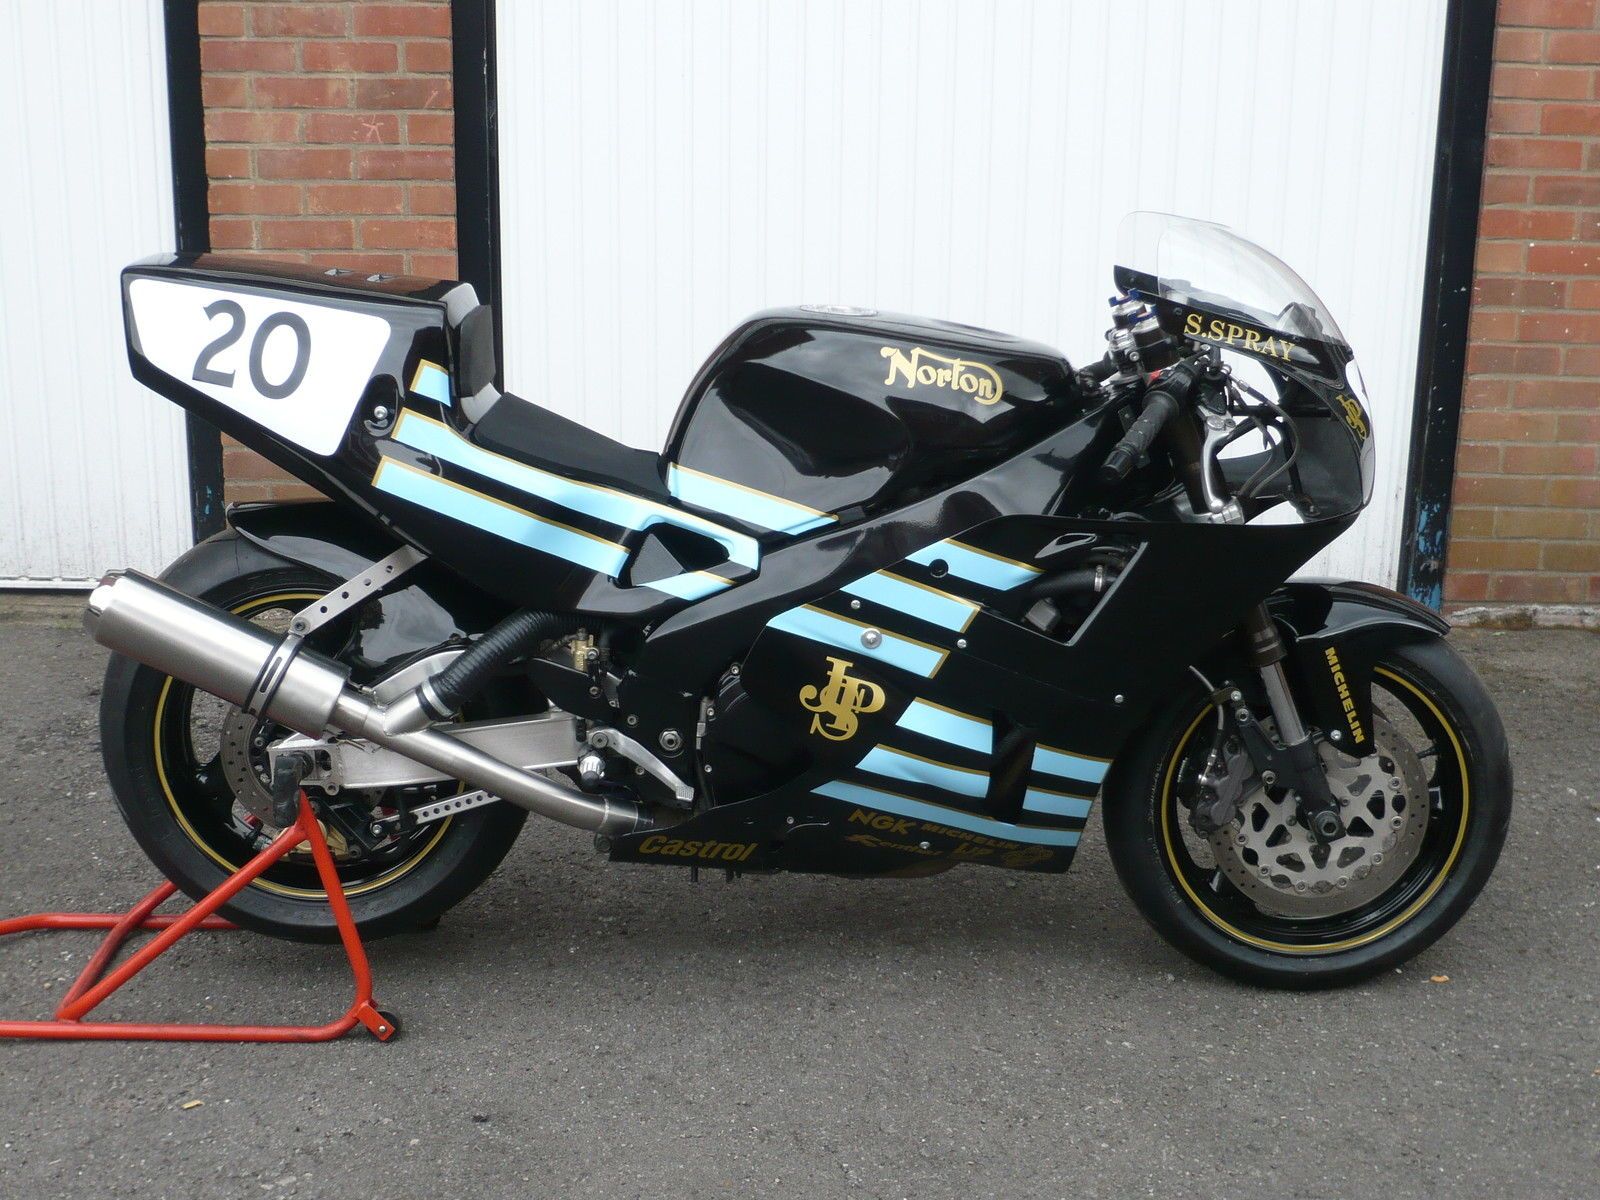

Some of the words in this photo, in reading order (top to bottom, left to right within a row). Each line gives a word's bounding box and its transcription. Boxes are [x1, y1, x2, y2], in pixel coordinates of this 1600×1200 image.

[192, 299, 311, 399] 20
[1184, 313, 1297, 362] S.SPRAY
[880, 346, 1003, 406] Norton
[1325, 646, 1365, 744] MICHELIN
[639, 834, 759, 862] Castrol
[847, 808, 918, 835] NGK
